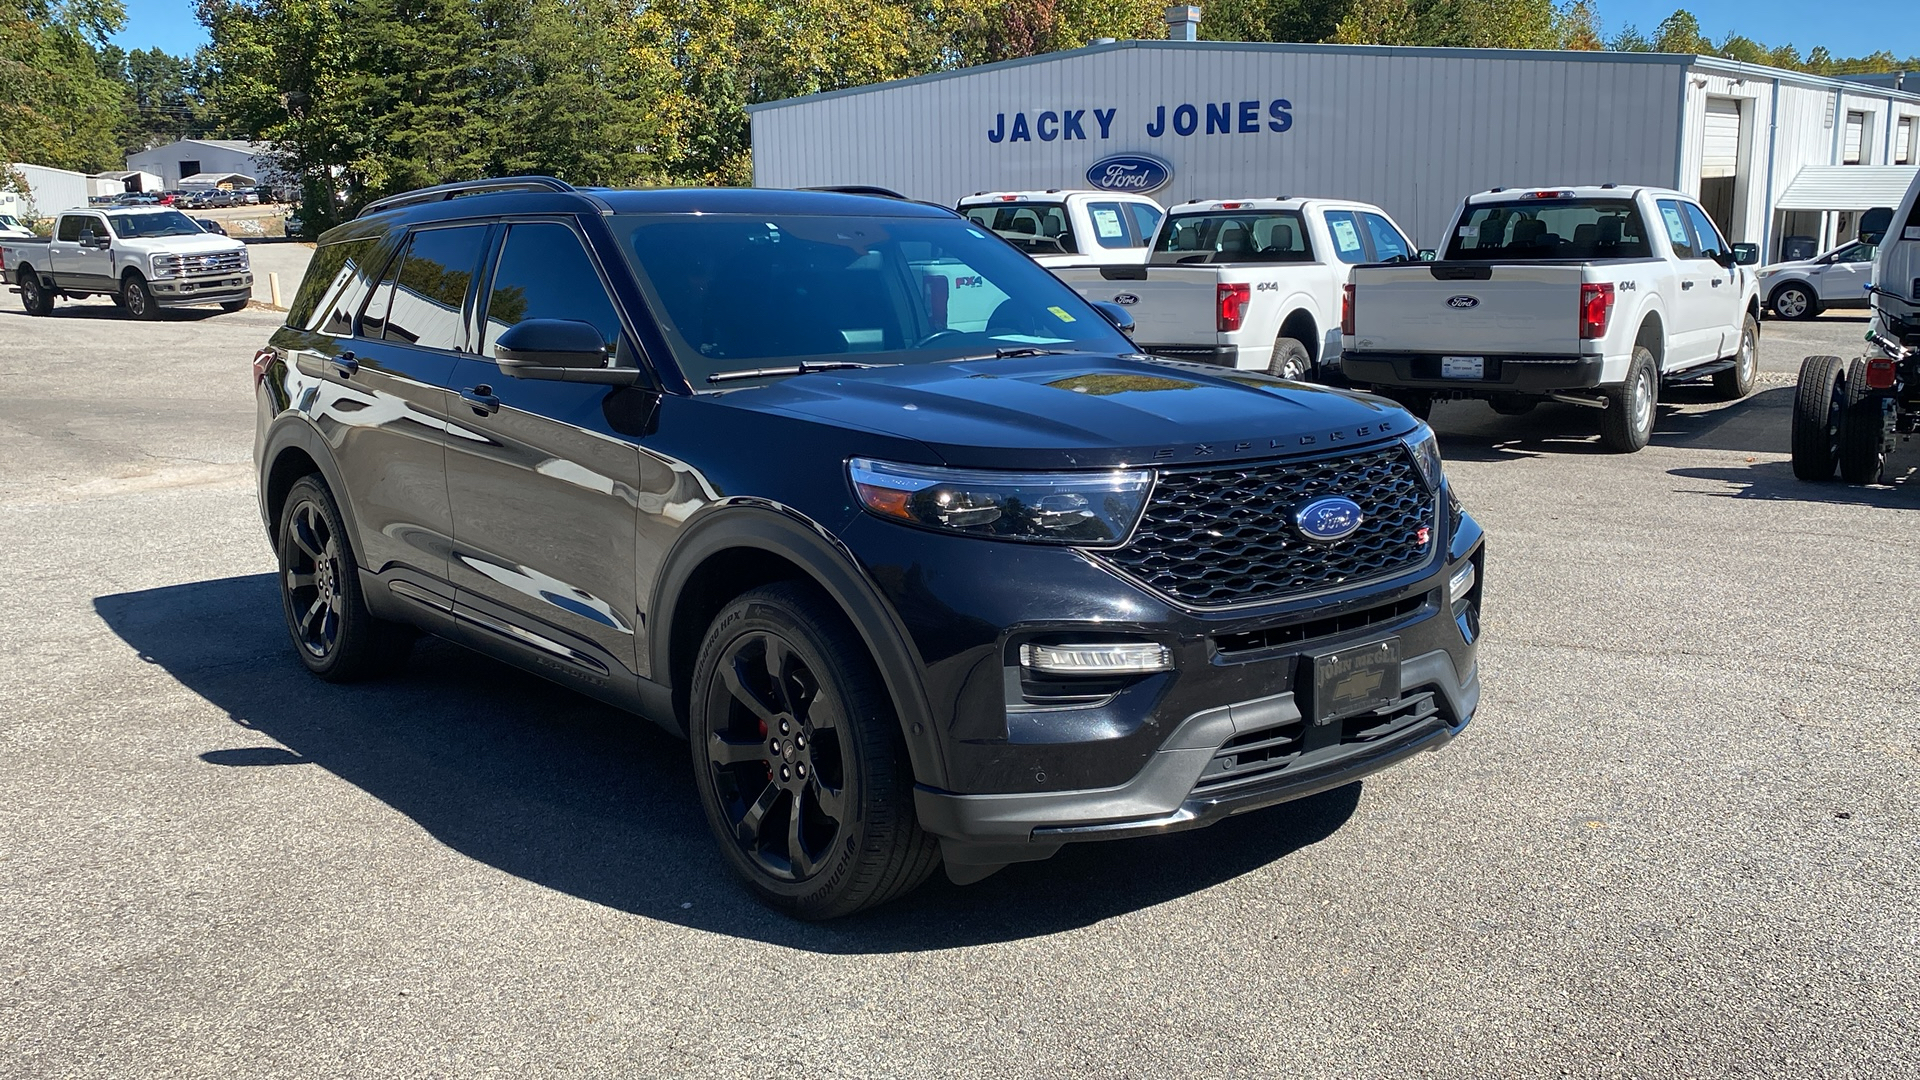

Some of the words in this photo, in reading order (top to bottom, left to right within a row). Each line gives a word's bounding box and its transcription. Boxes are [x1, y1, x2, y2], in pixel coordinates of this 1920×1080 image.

[987, 108, 1117, 143] JACKY
[1146, 99, 1293, 137] JONES
[1102, 164, 1149, 187] Ford
[956, 276, 982, 289] FX4
[1153, 421, 1393, 459] EXPLORER
[1317, 506, 1350, 531] Ford
[720, 609, 742, 632] HPX
